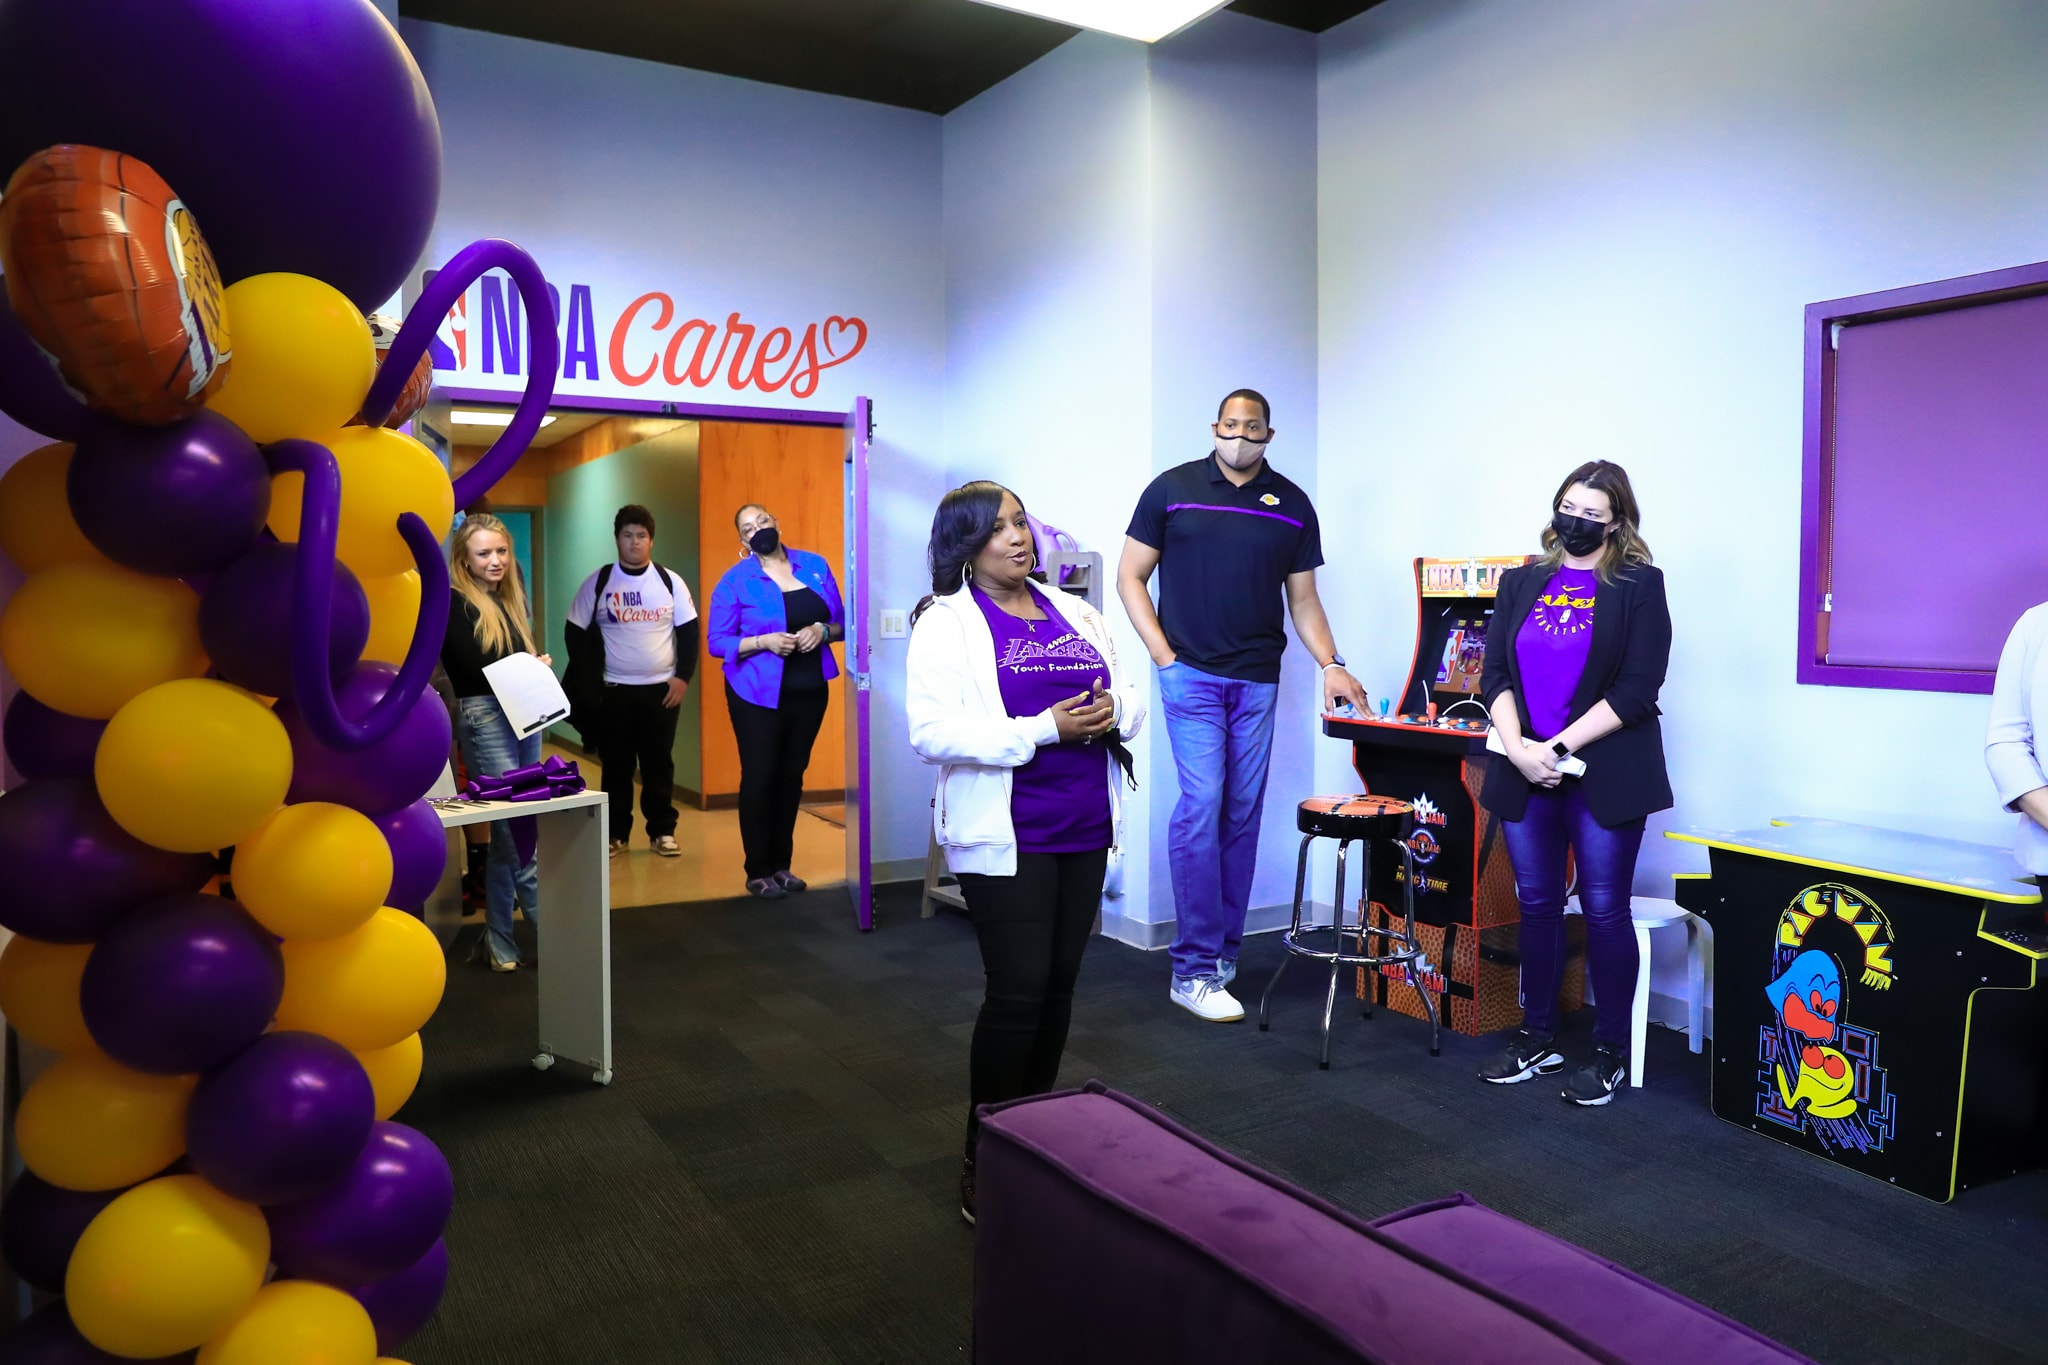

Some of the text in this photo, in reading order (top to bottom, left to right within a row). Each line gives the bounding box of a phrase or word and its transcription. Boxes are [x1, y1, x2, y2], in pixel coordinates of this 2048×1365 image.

[608, 291, 822, 400] Cares
[1428, 565, 1465, 590] NBA
[623, 591, 642, 606] NBA
[621, 607, 661, 623] Cares
[1010, 662, 1104, 674] Youth Foundation
[1395, 871, 1449, 892] HG TIME
[1382, 963, 1406, 982] NBA
